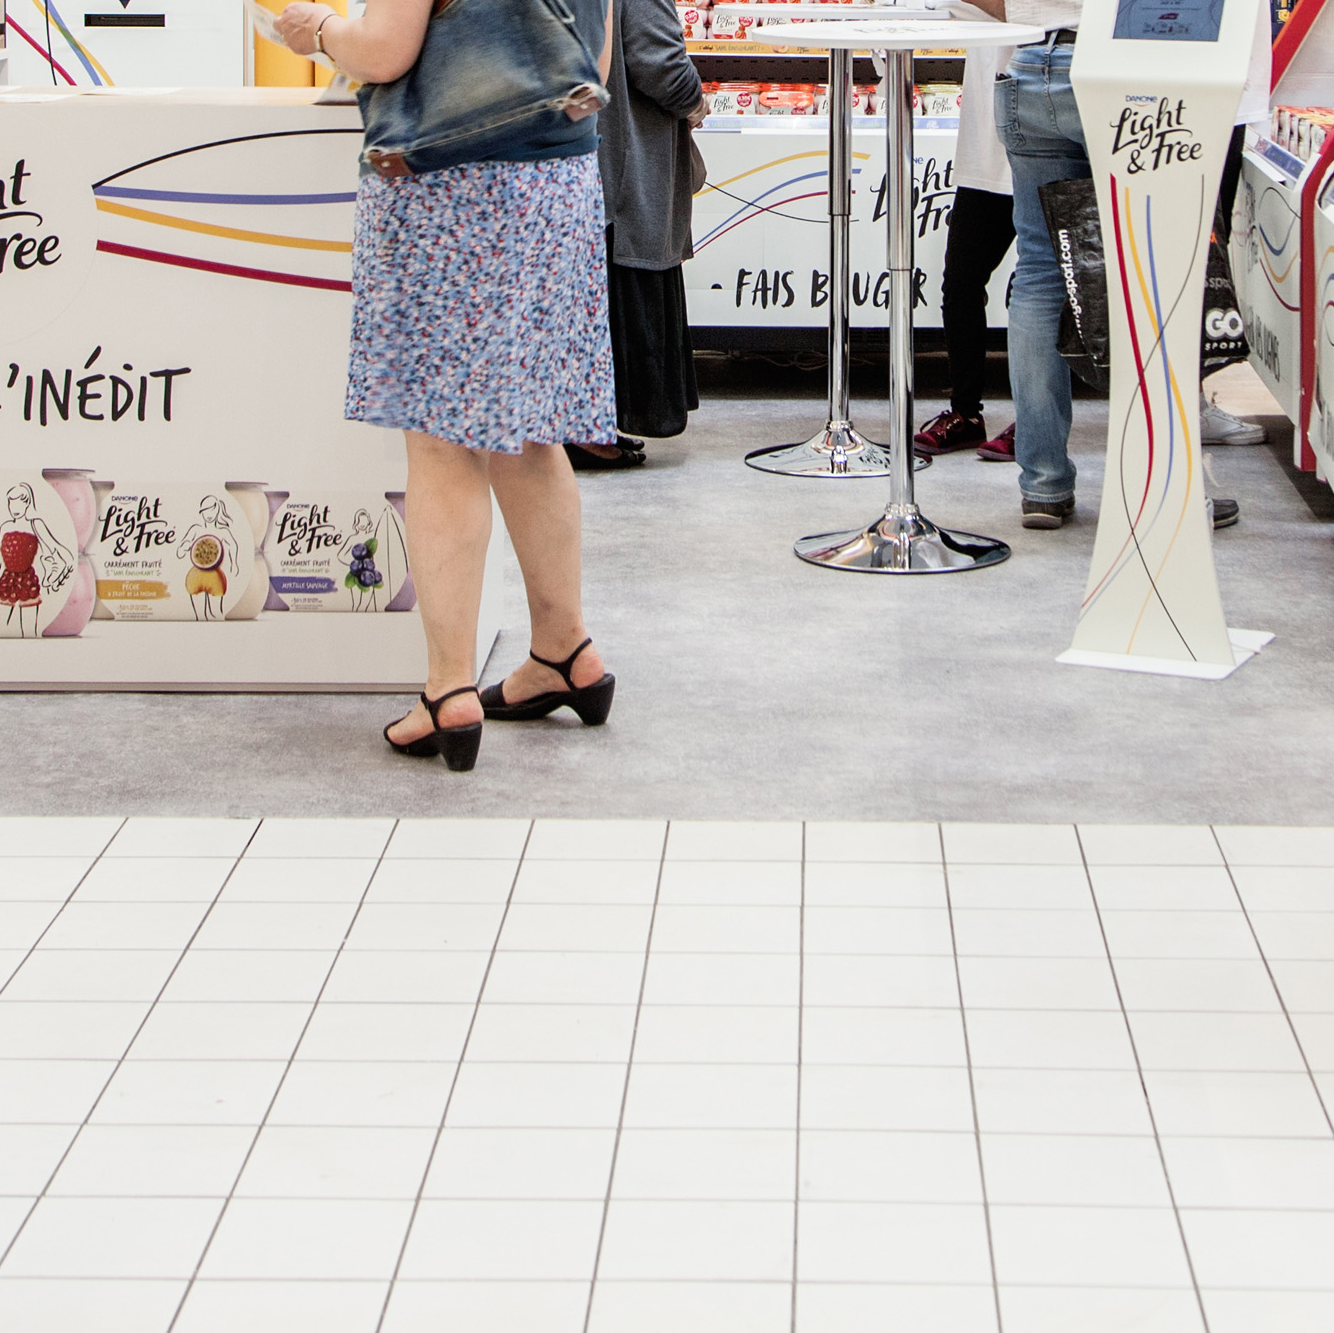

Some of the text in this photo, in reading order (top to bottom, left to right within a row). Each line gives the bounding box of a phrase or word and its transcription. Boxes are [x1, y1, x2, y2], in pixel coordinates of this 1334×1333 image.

[1109, 97, 1186, 156] Light
[1127, 129, 1203, 174] & Free
[870, 158, 955, 222] Lht
[735, 268, 928, 310] FAIS BUGR
[1205, 308, 1243, 339] GO
[1205, 342, 1243, 350] SPORT
[99, 496, 162, 543] Light
[114, 519, 176, 557] & Free
[275, 505, 331, 546] Light
[288, 525, 342, 557] & Free
